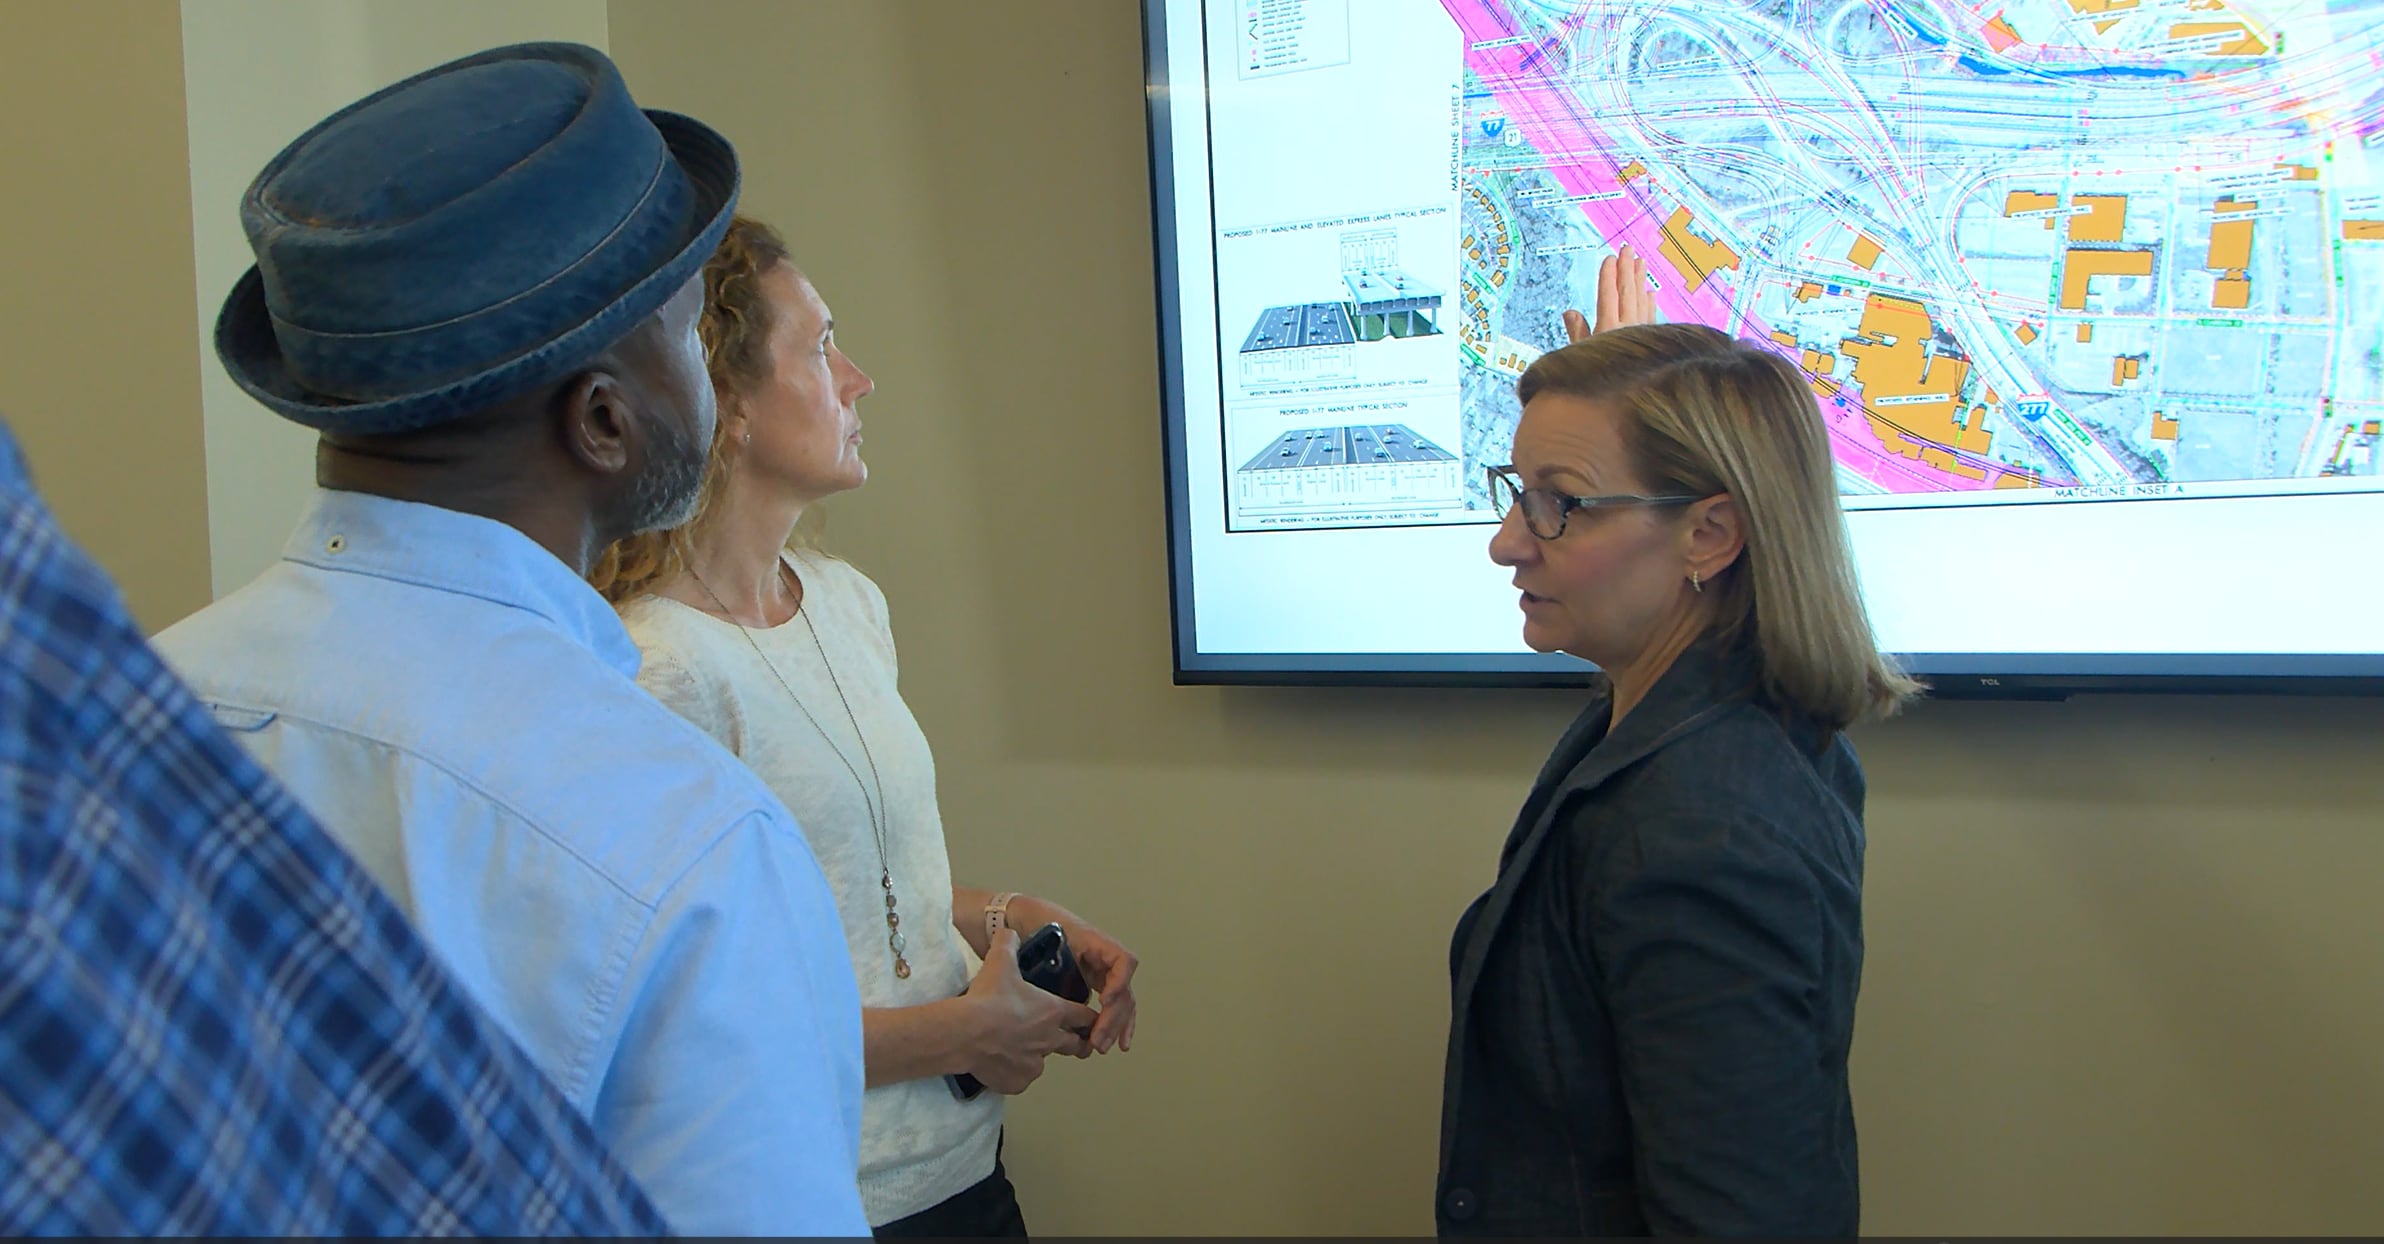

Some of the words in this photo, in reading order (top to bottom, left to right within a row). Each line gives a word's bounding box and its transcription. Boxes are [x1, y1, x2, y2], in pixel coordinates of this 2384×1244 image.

[1451, 96, 1460, 127] SHEET
[1486, 120, 1500, 132] 77
[1508, 132, 1518, 143] 21
[1450, 132, 1459, 192] MATCHLINE
[1347, 216, 1370, 225] EXPRESS
[1373, 213, 1391, 222] LANES
[2020, 403, 2047, 416] 277
[2054, 486, 2126, 498] MATCHLINE
[2133, 484, 2167, 495] INSET
[2174, 485, 2184, 493] A
[1980, 678, 2000, 686] TCL
